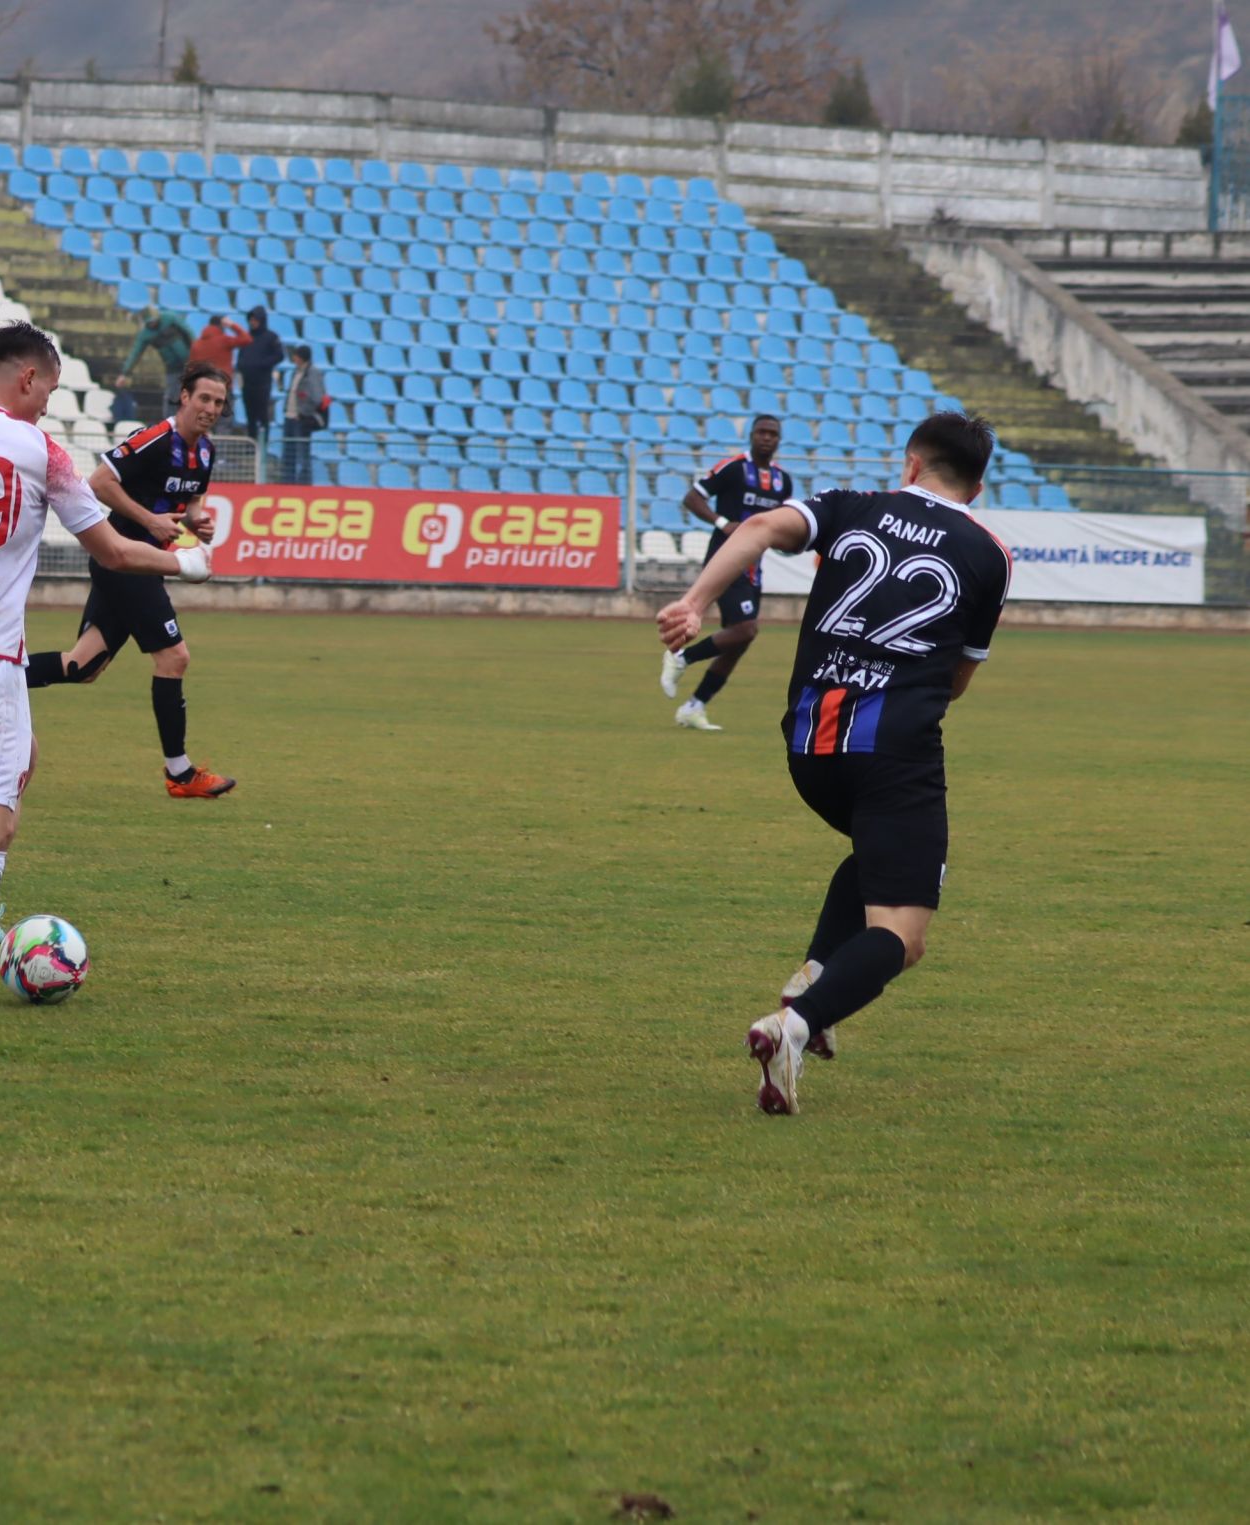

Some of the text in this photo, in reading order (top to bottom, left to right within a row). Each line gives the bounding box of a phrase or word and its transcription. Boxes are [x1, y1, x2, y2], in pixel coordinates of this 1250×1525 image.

[239, 496, 375, 540] casa
[469, 504, 603, 548] casa
[877, 513, 947, 548] PANAIT
[236, 537, 368, 562] pariurilor
[465, 544, 596, 569] pariurilor
[1011, 545, 1090, 567] ORMANȚĂ
[814, 529, 961, 658] 22
